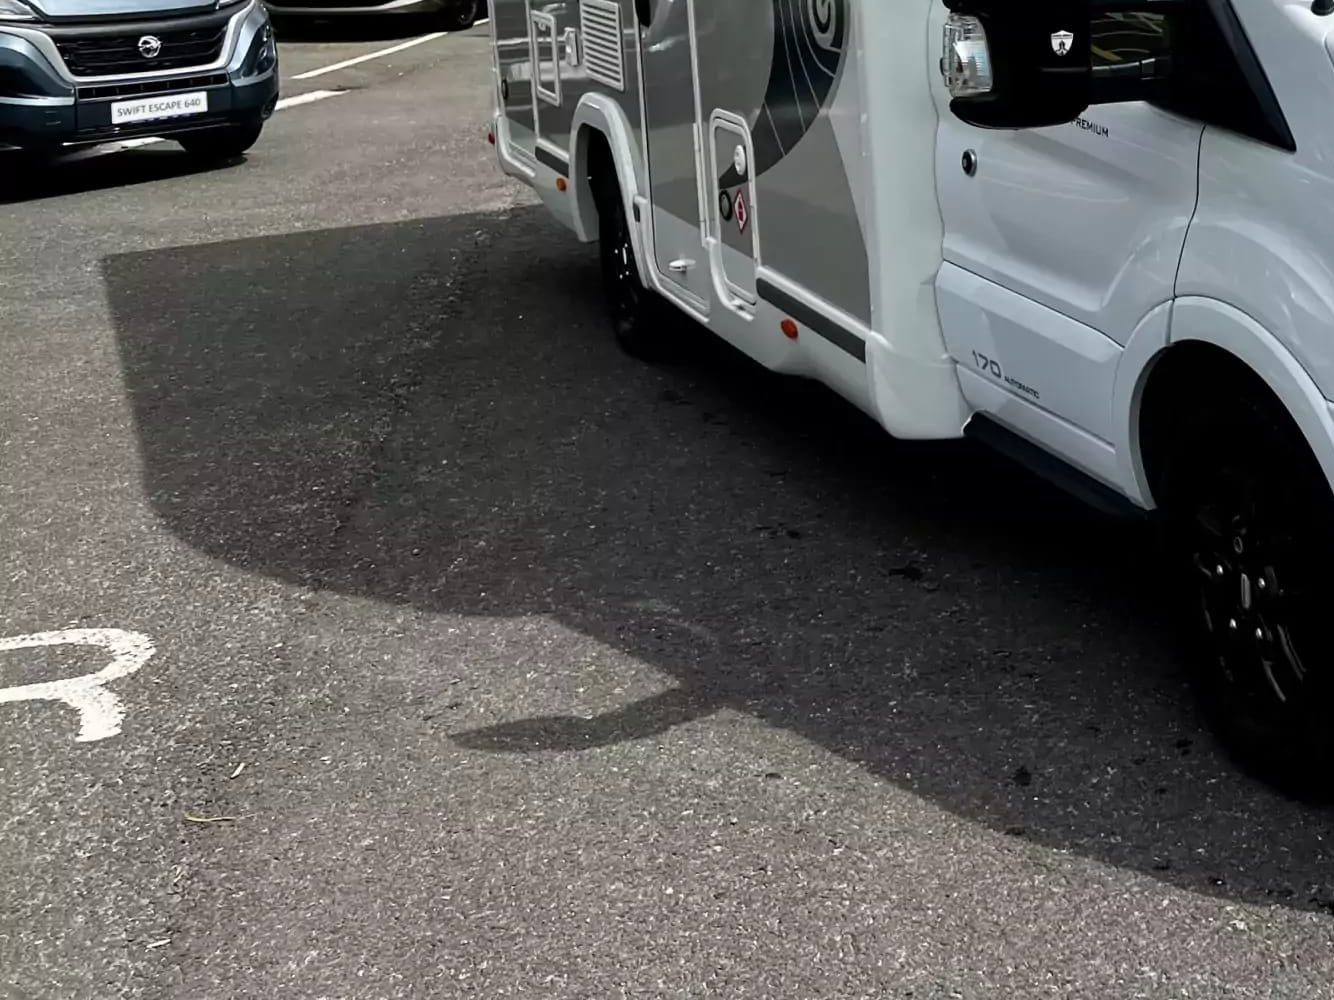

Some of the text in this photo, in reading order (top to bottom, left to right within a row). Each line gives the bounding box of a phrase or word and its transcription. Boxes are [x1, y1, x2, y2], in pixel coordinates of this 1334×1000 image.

[117, 98, 200, 117] SWIFT ESCAPE 640
[971, 349, 1002, 378] 170
